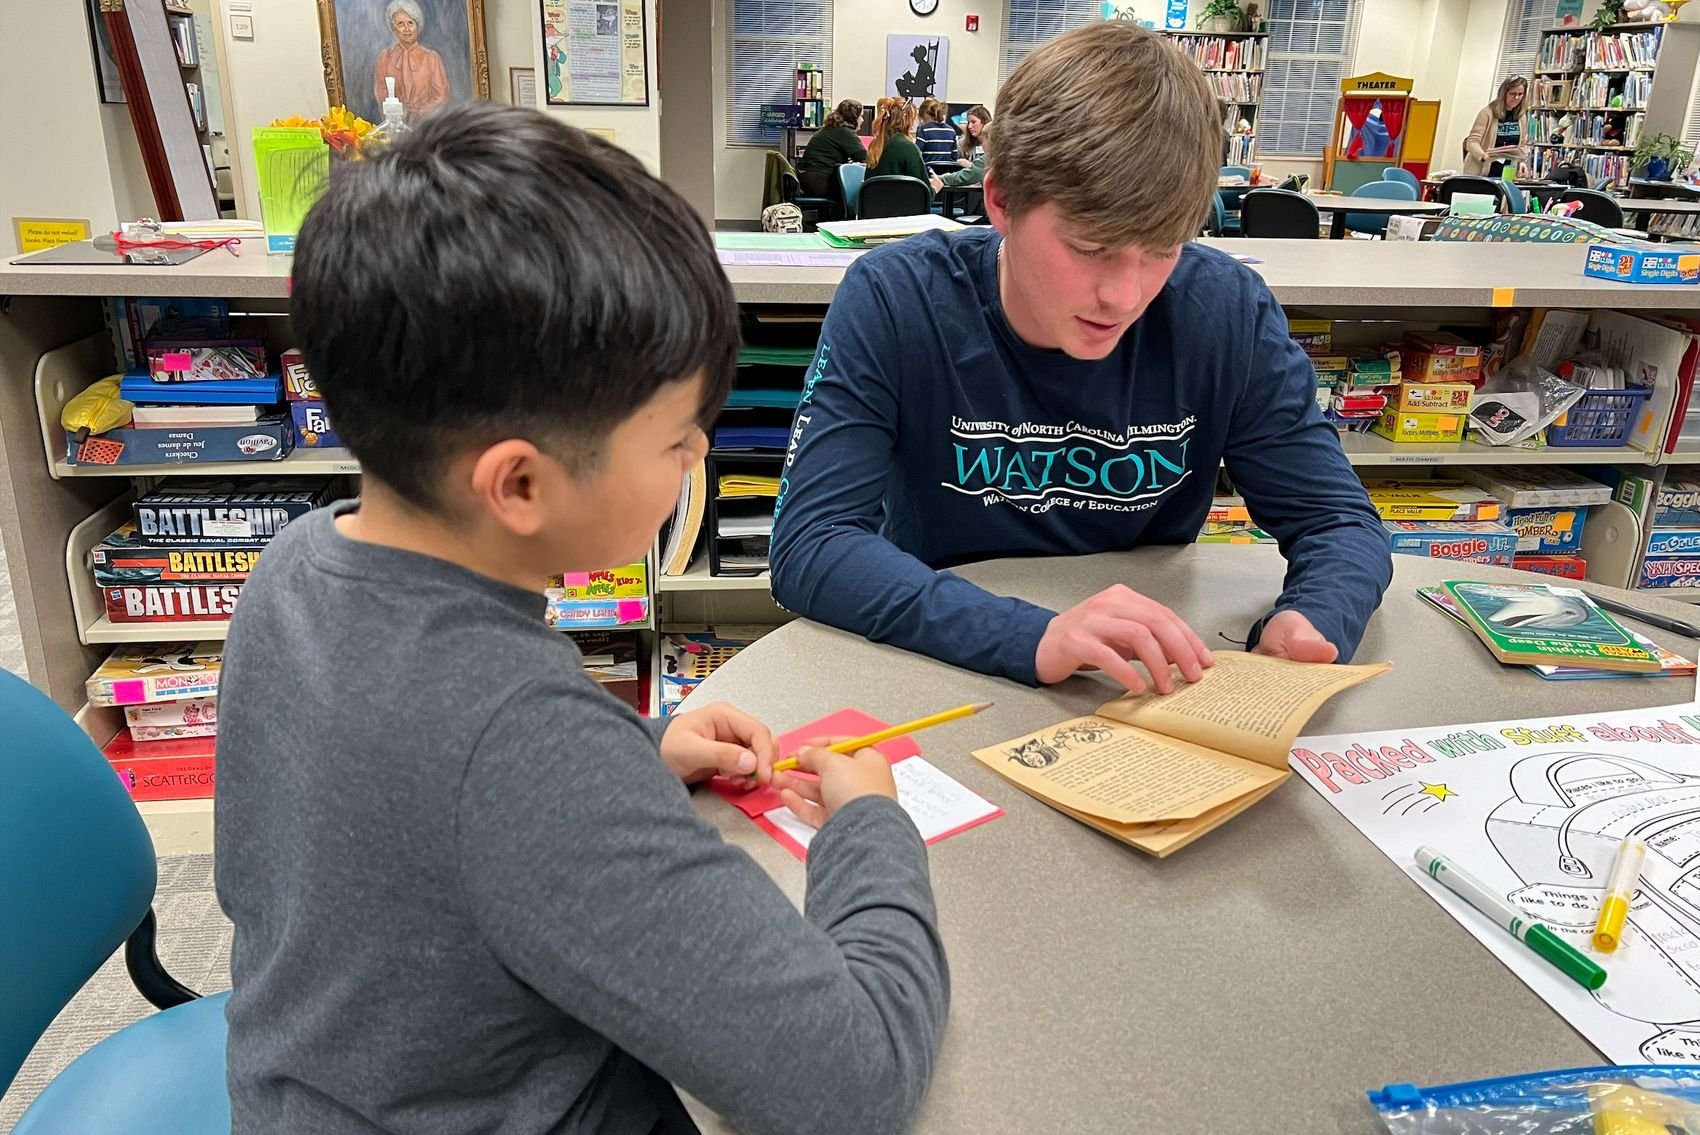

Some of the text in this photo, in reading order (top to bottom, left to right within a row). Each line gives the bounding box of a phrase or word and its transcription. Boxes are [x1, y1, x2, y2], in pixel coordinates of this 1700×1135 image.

[1357, 81, 1396, 89] THEATER
[1641, 270, 1678, 278] Single Digits
[802, 343, 830, 405] LEARN
[1486, 408, 1510, 428] UNO
[1011, 424, 1022, 437] of
[1022, 422, 1064, 435] NORTH
[1066, 420, 1125, 443] CAROLINA
[194, 440, 206, 448] Jeu
[240, 438, 275, 447] Pavilion
[786, 414, 811, 467] LEAD
[165, 451, 199, 459] Checkers
[953, 438, 1190, 495] WATSON
[983, 493, 1028, 512] WATN
[1073, 501, 1085, 509] of
[1088, 500, 1158, 512] EDUCATION
[1513, 515, 1534, 526] Head
[1535, 511, 1549, 522] Full
[1430, 538, 1487, 558] Boggle
[1490, 537, 1511, 551] Jr.
[1651, 537, 1700, 553] BOGGLE
[169, 552, 262, 572] BATTLESH
[616, 577, 634, 586] KIDS
[125, 588, 240, 616] BATTLES
[560, 610, 590, 618] CANDY
[1508, 638, 1546, 646] Deep
[1537, 646, 1598, 657] Dolphin
[156, 674, 218, 689] MONOPO
[1290, 738, 1437, 794] Packed
[1426, 729, 1507, 759] with
[1587, 719, 1693, 745] about
[1565, 784, 1592, 793] Places
[1541, 890, 1588, 901] Things
[1520, 896, 1546, 905] like
[1549, 899, 1566, 908] to
[1679, 1038, 1700, 1047] Th
[1656, 1047, 1685, 1059] like
